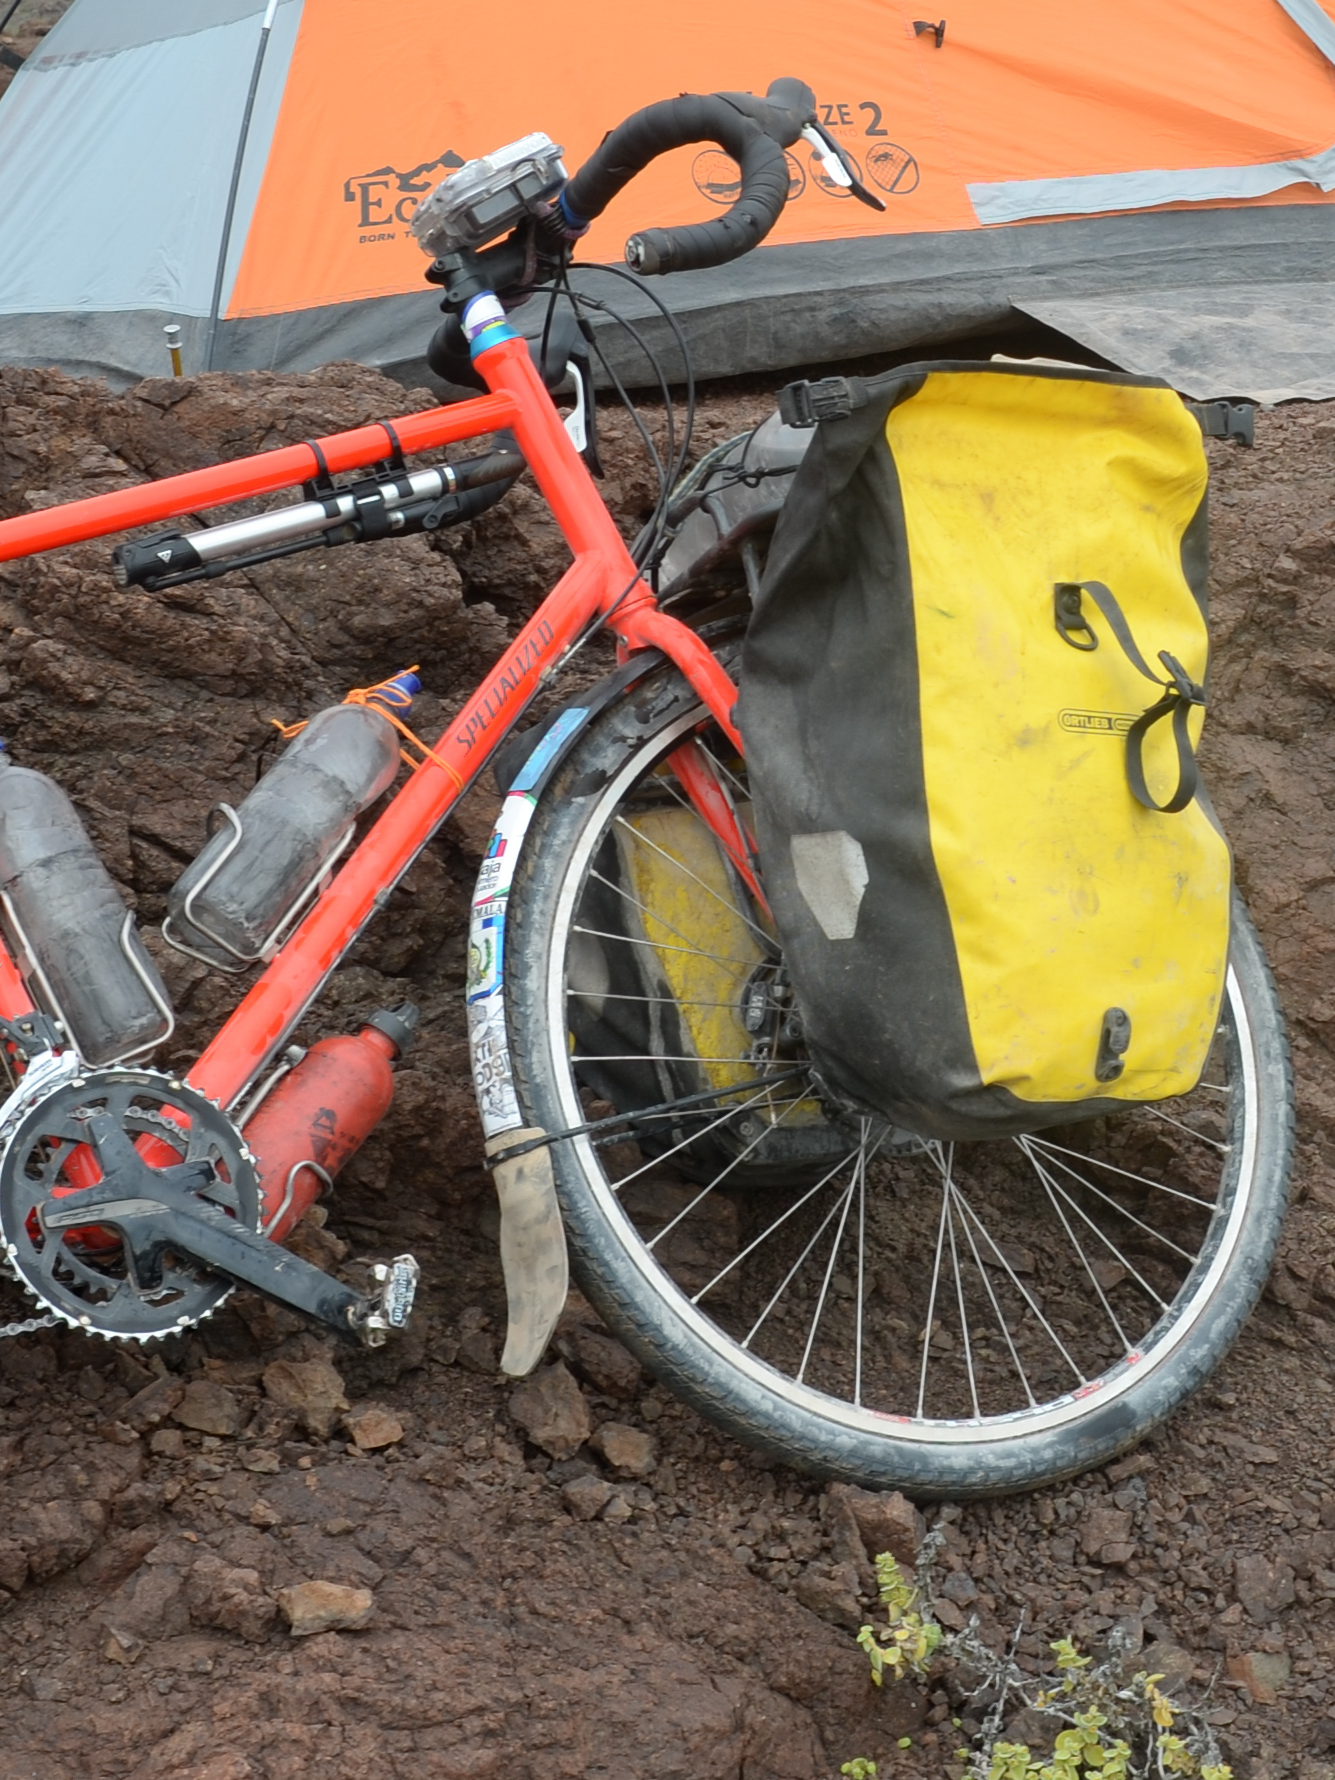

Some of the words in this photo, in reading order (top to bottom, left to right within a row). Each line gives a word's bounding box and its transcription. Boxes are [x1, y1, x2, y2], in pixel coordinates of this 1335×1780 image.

[858, 101, 888, 137] 2
[359, 232, 396, 244] BORN
[1062, 713, 1110, 730] ORTLIEB
